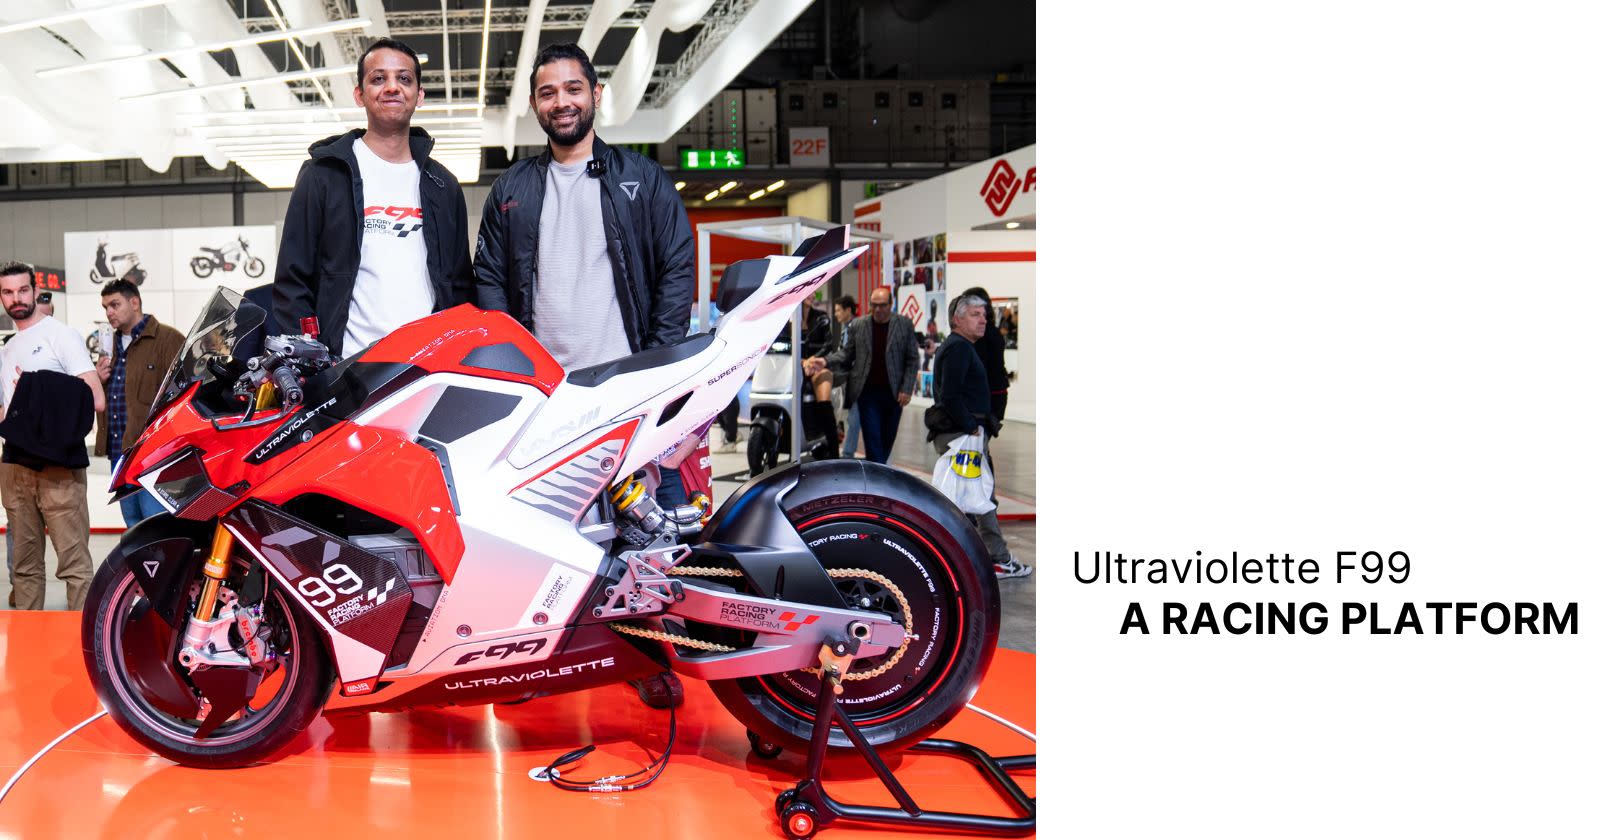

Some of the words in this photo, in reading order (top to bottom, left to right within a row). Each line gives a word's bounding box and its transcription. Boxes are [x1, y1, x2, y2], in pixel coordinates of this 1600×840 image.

[792, 138, 827, 156] 22F
[365, 218, 392, 226] CTORY
[767, 271, 828, 305] F99
[255, 396, 337, 459] ULTRAVIOLETTE
[802, 495, 875, 512] METZELER
[808, 537, 828, 548] TORY
[829, 533, 858, 542] RACING
[883, 538, 929, 579] ULTRAVIOLETTE
[297, 563, 363, 608] 99
[542, 575, 563, 607] FACTORY
[546, 583, 564, 609] RACING
[327, 593, 364, 616] FACTORY
[330, 602, 361, 621] RACING
[332, 602, 375, 627] PLATFORM
[720, 607, 766, 620] RACING
[722, 601, 777, 615] FACTORY
[719, 613, 780, 630] PLATFORM
[930, 607, 940, 641] FACTORY
[454, 637, 548, 666] F99
[918, 641, 935, 667] RACING
[444, 656, 616, 690] ULTRAVIOLETTE
[845, 683, 902, 704] ULTRAVIOLETTE
